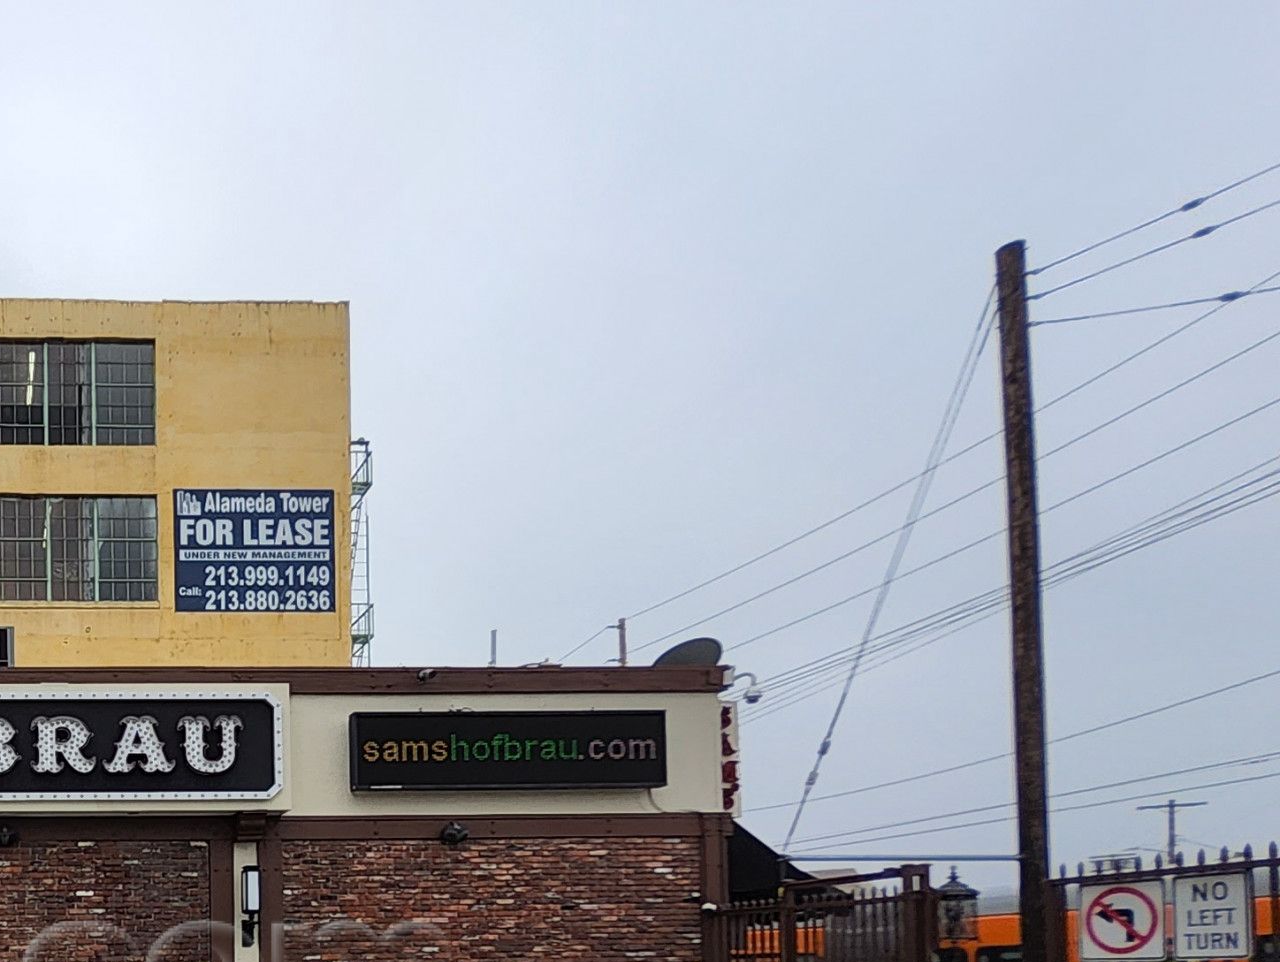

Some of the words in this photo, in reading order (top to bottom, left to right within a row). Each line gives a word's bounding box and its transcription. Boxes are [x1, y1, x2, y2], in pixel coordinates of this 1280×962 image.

[204, 492, 276, 513] Alameda
[279, 492, 330, 513] Tower
[179, 518, 234, 546] FOR
[242, 518, 330, 546] LEASE
[184, 551, 220, 560] UNDER
[223, 551, 248, 560] NEW
[251, 550, 327, 560] MANAGEMENT
[204, 565, 330, 587] 213.999.1149
[178, 586, 203, 597] Call:
[204, 590, 331, 611] 213.880.2636
[362, 733, 658, 763] samshofbrau.com
[1191, 881, 1229, 902] NO
[1187, 907, 1236, 927] LEFT
[1184, 932, 1239, 950] TURN
